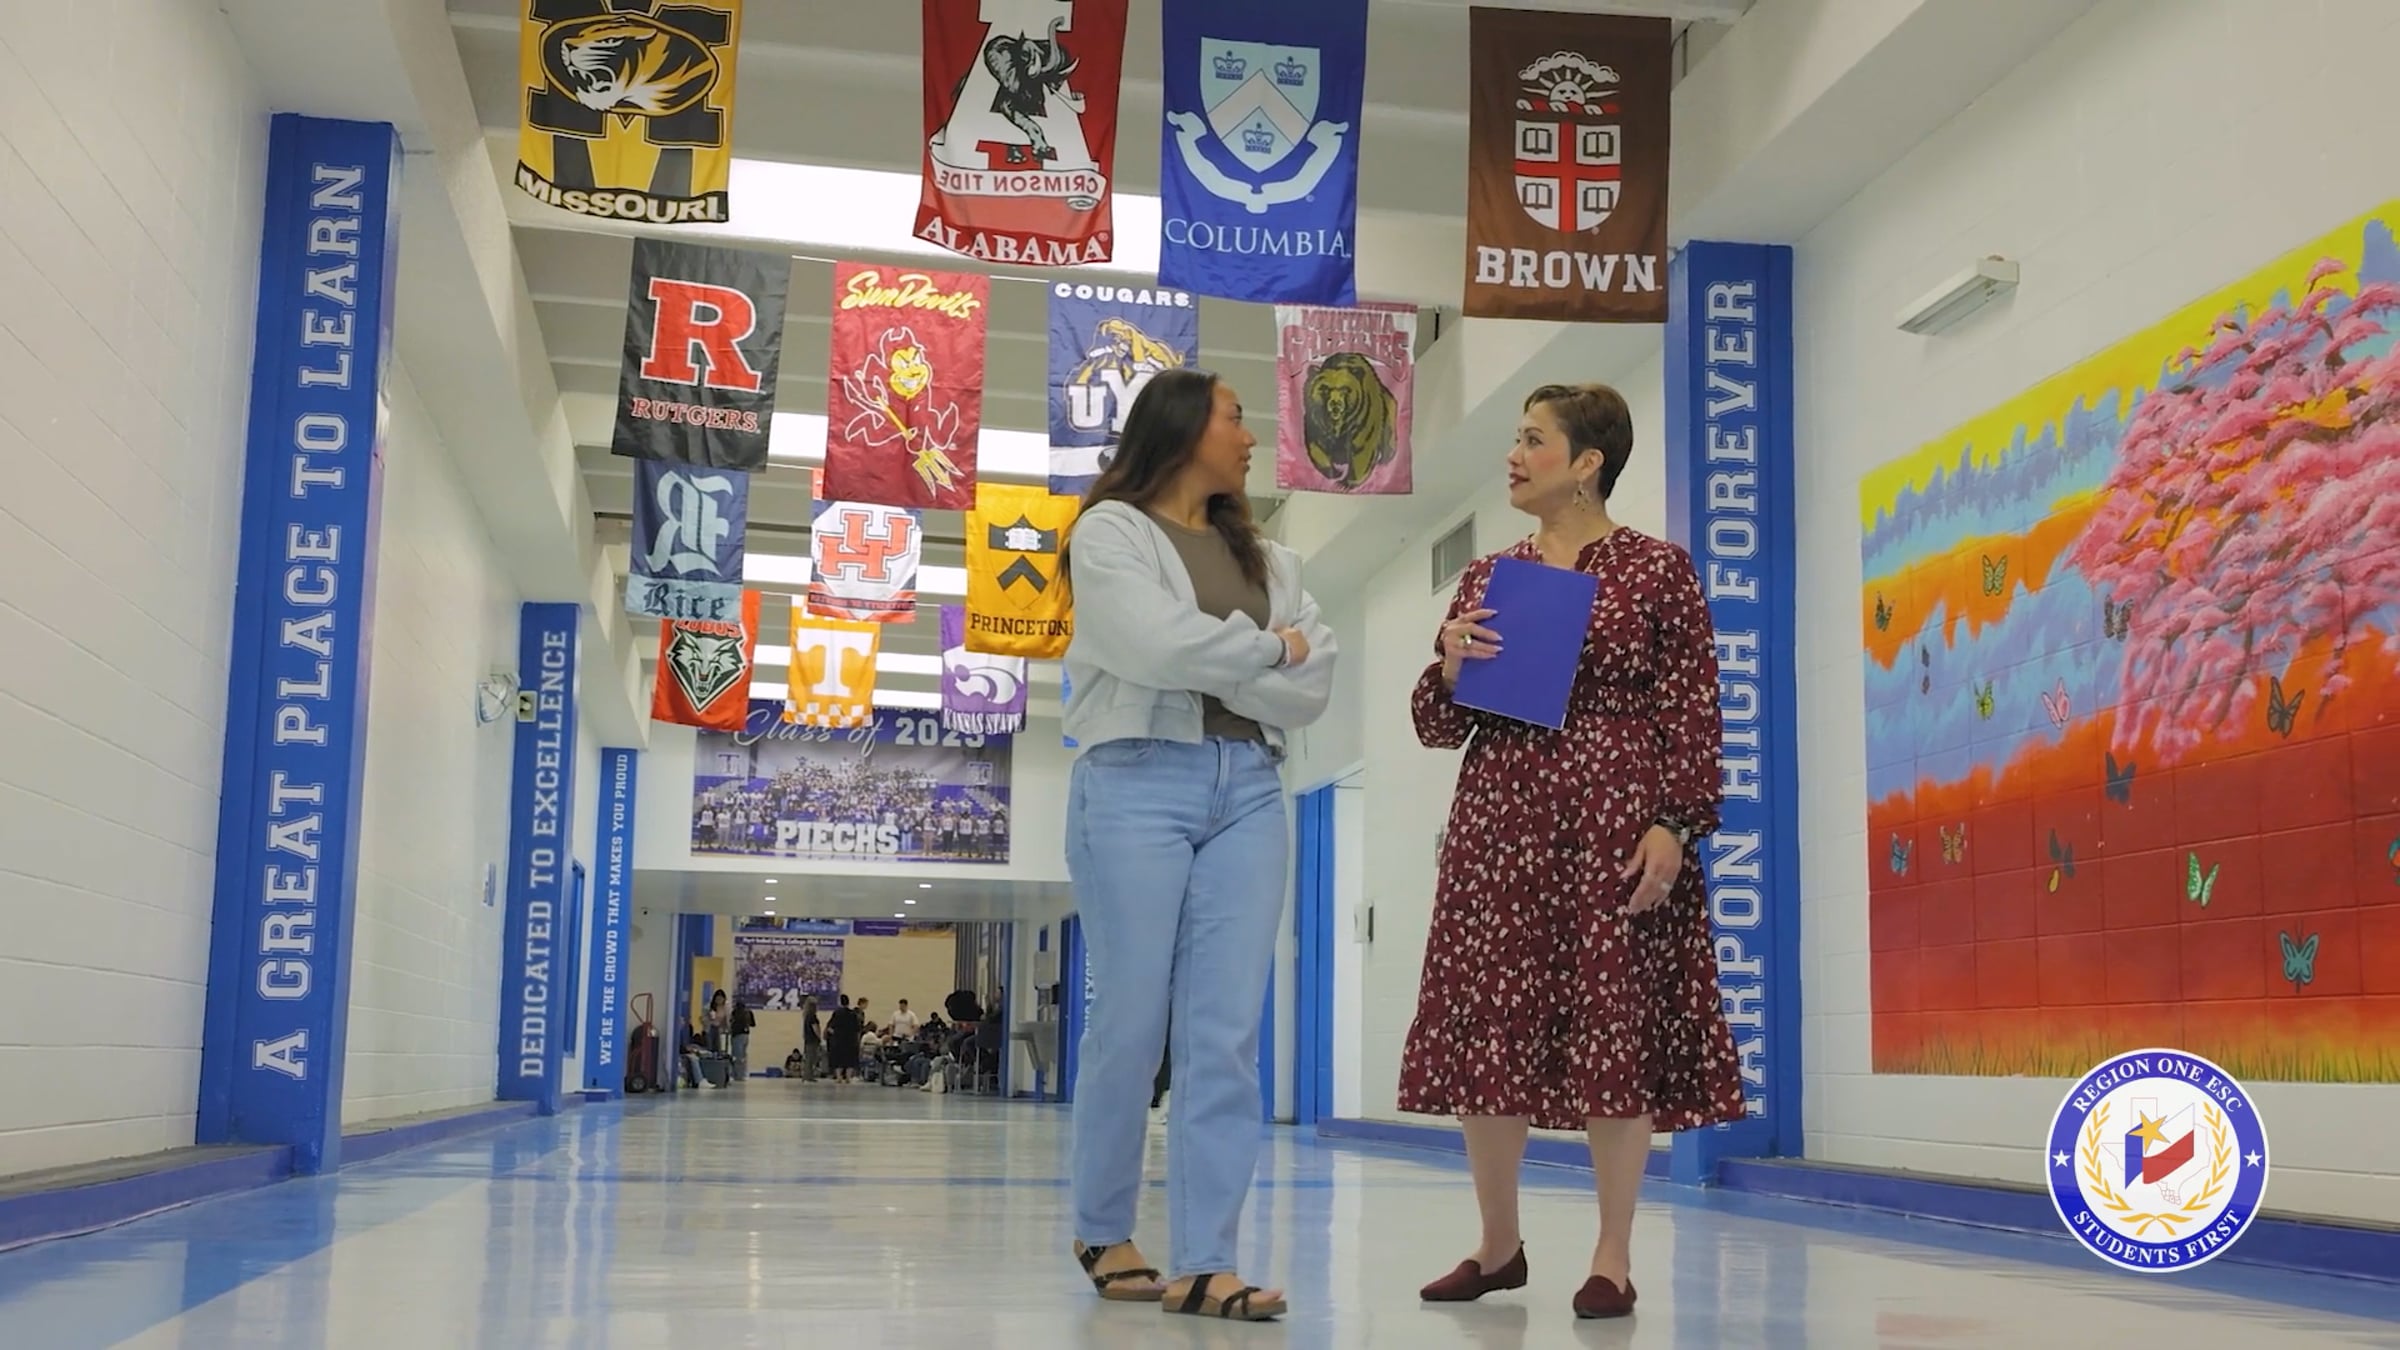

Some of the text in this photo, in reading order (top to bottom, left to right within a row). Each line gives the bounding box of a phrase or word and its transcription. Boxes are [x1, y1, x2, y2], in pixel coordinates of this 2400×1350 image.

[518, 167, 720, 223] MISSOURI
[918, 215, 1109, 266] ALABAMA
[1164, 218, 1348, 257] COLUMBIA
[840, 270, 900, 310] Sun
[1475, 245, 1657, 292] BROWN
[1054, 282, 1190, 307] COUGARS
[640, 277, 762, 394] R
[632, 397, 759, 433] RUTGERS
[1704, 279, 1759, 603] FOREVER
[252, 162, 366, 1080] A GREAT PLACE TO LEARN
[643, 582, 726, 620] Rice
[970, 612, 1070, 637] PRINCETON
[797, 626, 875, 698] T
[733, 708, 836, 746] Class
[847, 716, 884, 758] of
[942, 707, 1023, 736] KANSAS STATE
[1714, 629, 1761, 802] HIGH
[520, 630, 567, 1078] DEDICATED TO EXCELLENCE
[775, 820, 901, 855] PIECHS
[600, 754, 629, 1066] WE'RE THE CROWD THAT MAKES YOU PROUD
